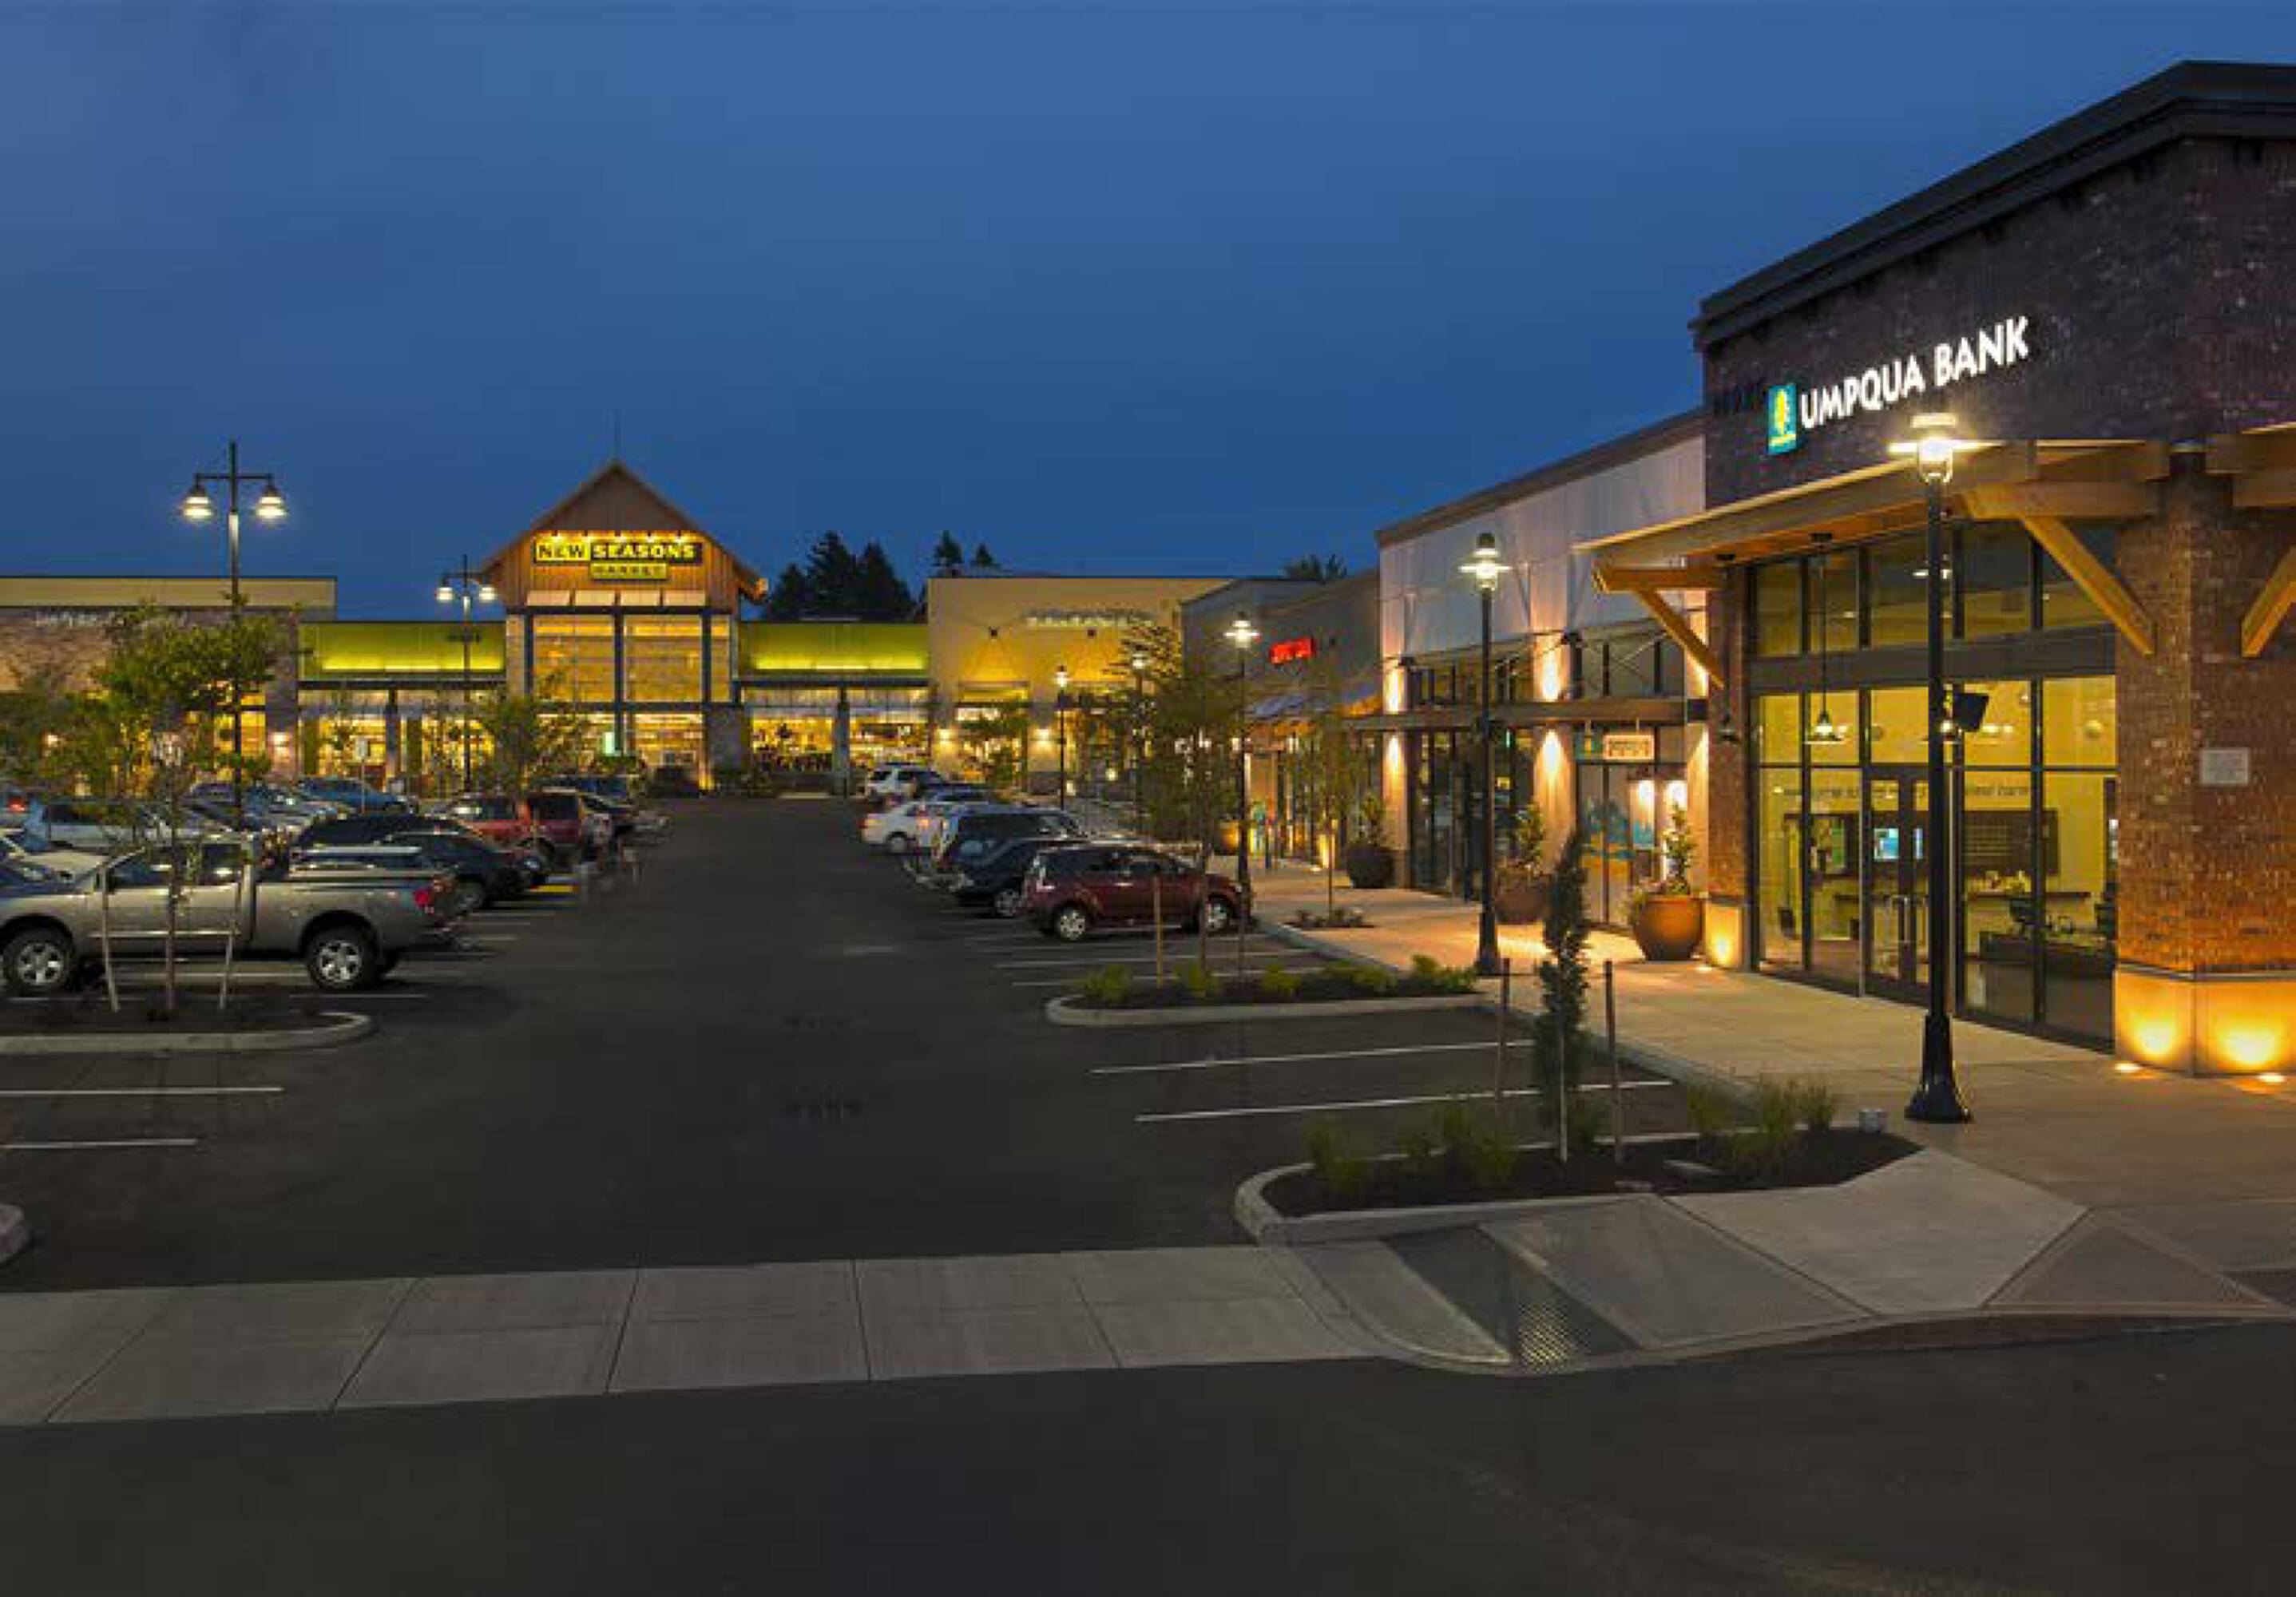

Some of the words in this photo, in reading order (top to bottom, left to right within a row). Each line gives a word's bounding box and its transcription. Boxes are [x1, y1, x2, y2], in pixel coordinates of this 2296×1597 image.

[1801, 355, 1926, 429] UMPQUA
[1933, 315, 2029, 386] BANK
[537, 544, 584, 558] NEW
[593, 543, 696, 559] SEASONS
